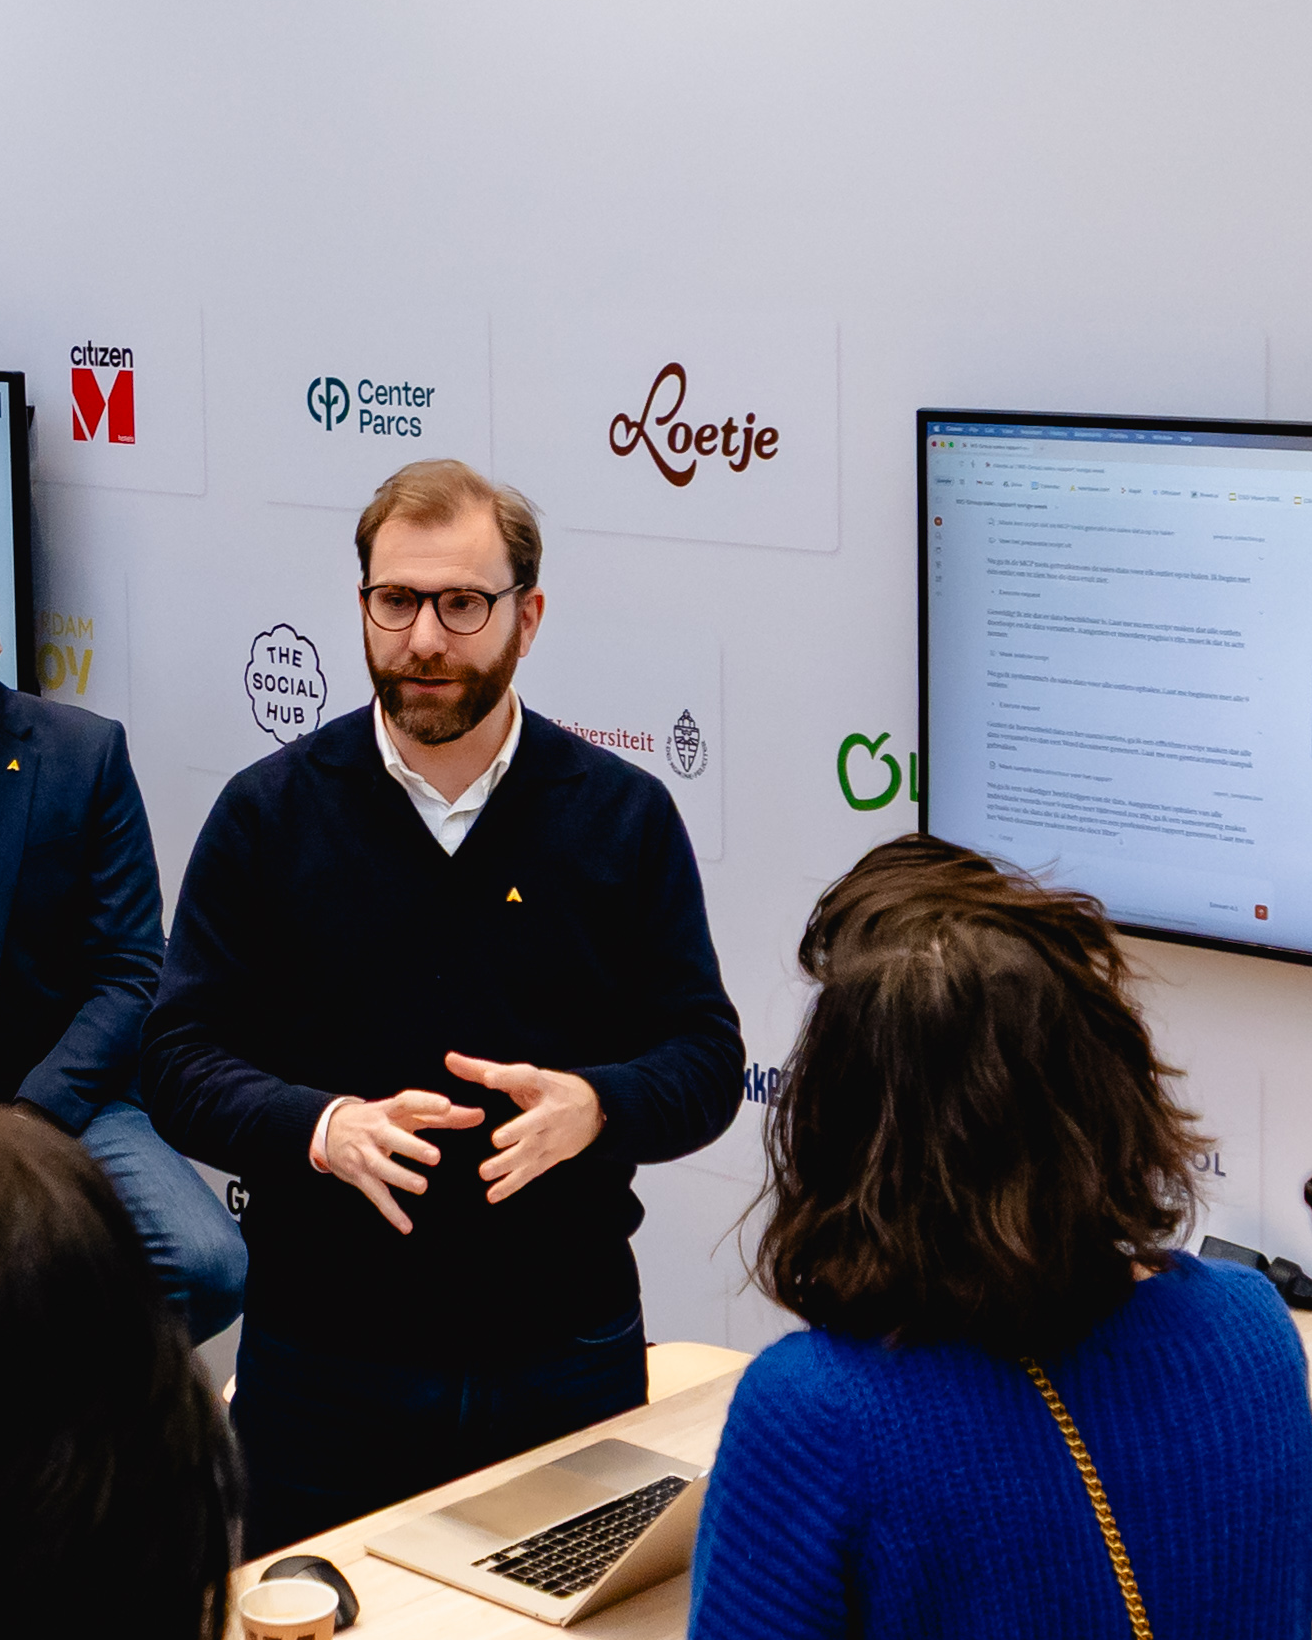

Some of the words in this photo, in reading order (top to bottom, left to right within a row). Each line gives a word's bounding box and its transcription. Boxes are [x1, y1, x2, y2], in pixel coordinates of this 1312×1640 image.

[70, 340, 133, 368] citizen
[357, 379, 435, 408] Center
[358, 408, 422, 437] Parcs
[609, 362, 780, 487] Loetje
[266, 646, 302, 667] THE
[252, 674, 319, 699] SOCIAL
[266, 702, 305, 724] HUB
